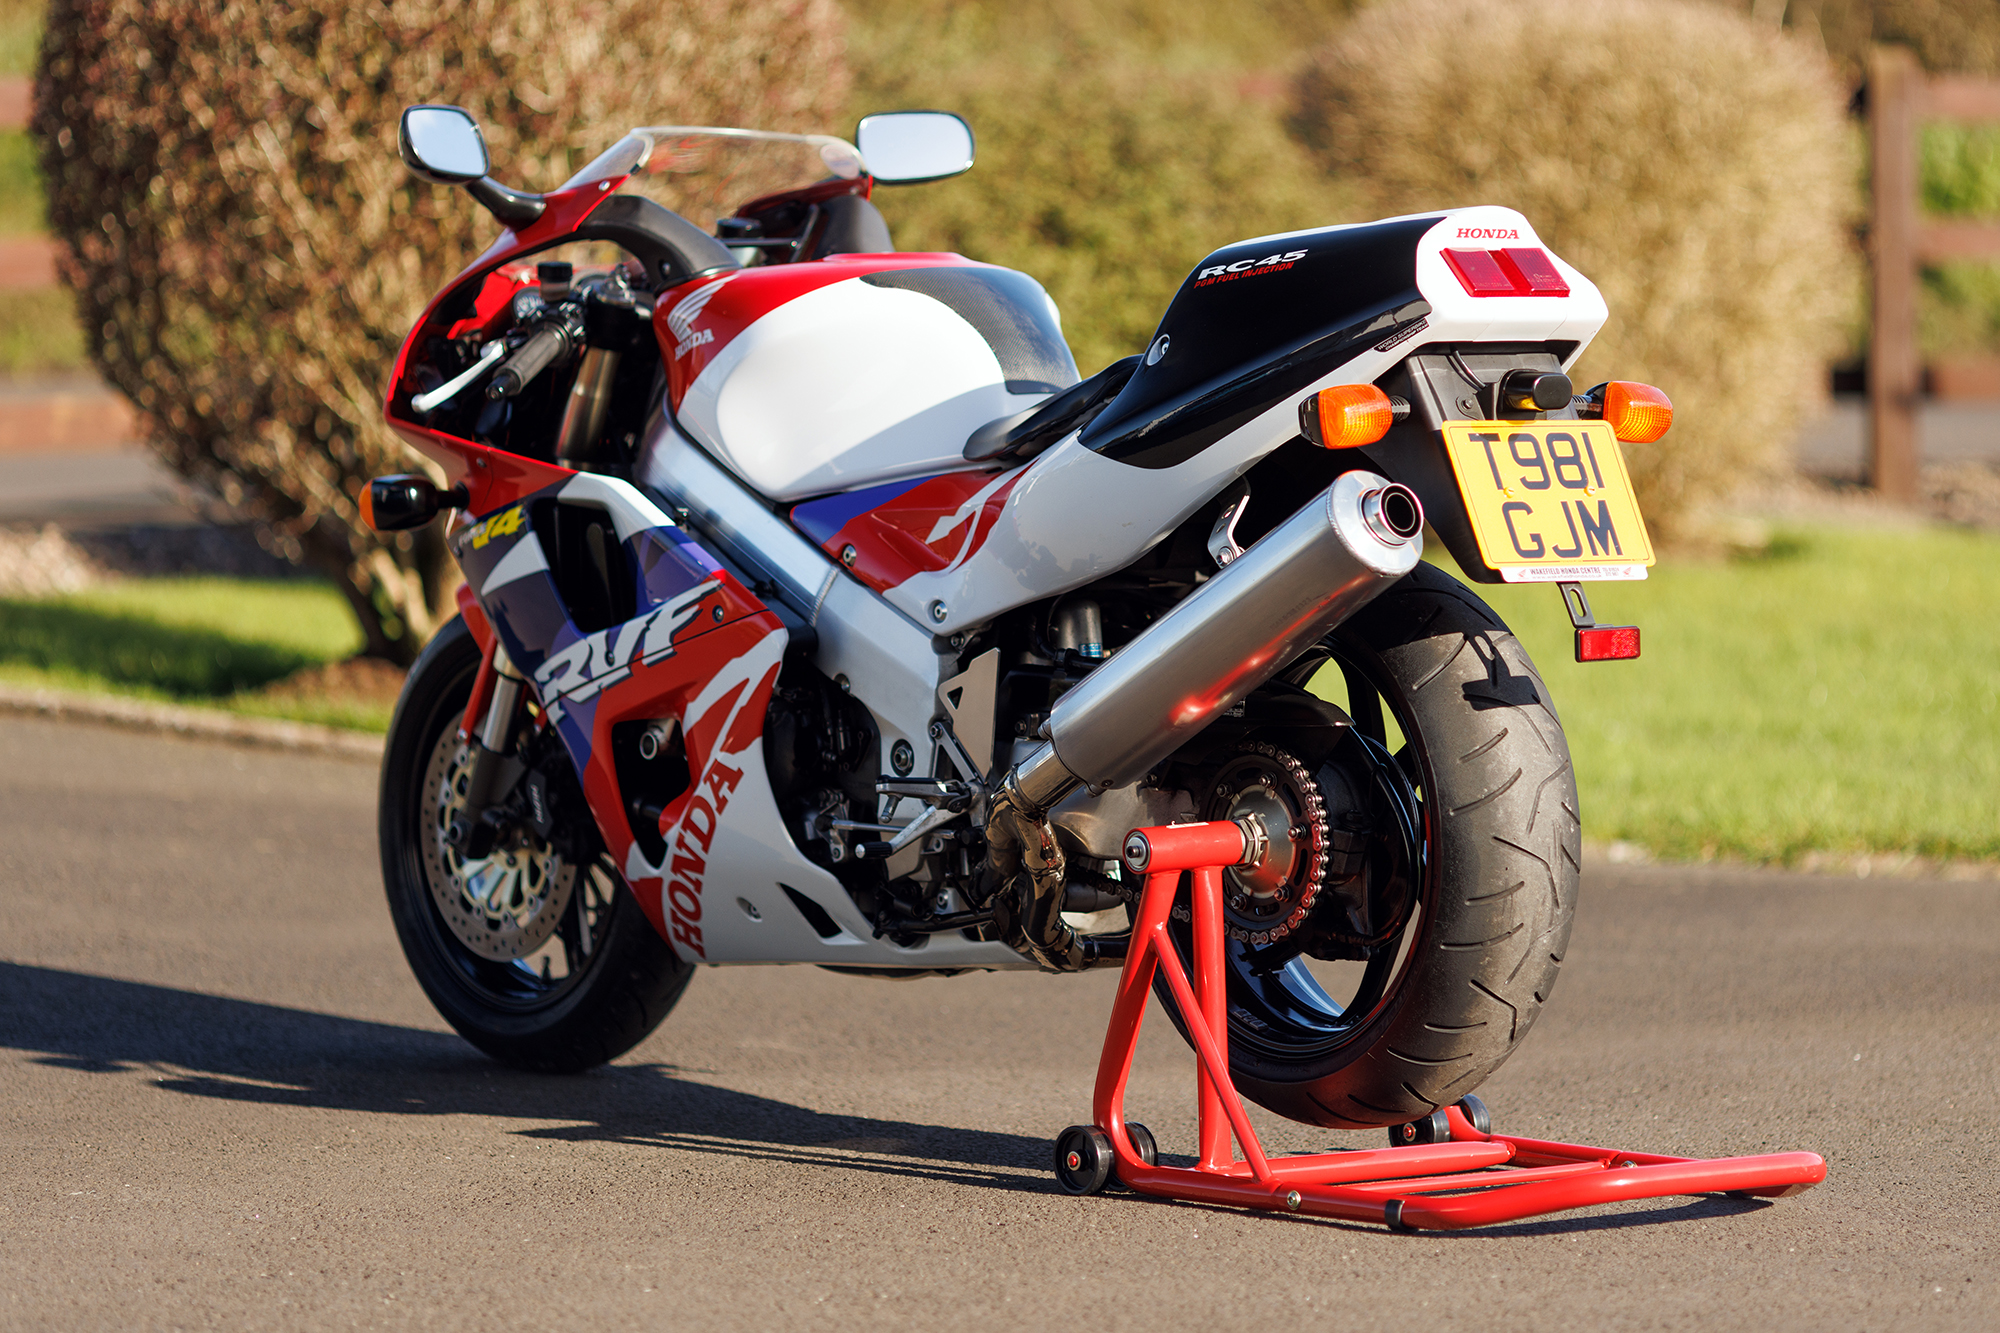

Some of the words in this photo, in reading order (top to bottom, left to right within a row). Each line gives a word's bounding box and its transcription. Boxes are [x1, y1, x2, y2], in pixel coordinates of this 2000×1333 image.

[1456, 228, 1520, 239] HONDA
[1193, 277, 1216, 289] PGM
[1216, 271, 1240, 283] FUEL
[1241, 262, 1295, 278] INJECTION
[1198, 249, 1309, 280] RC45
[675, 328, 715, 362] HONDA
[1467, 432, 1606, 491] T981
[1501, 500, 1624, 559] GJM
[1561, 567, 1579, 575] HONDA
[534, 579, 726, 727] RVF
[668, 758, 744, 960] HONDA
